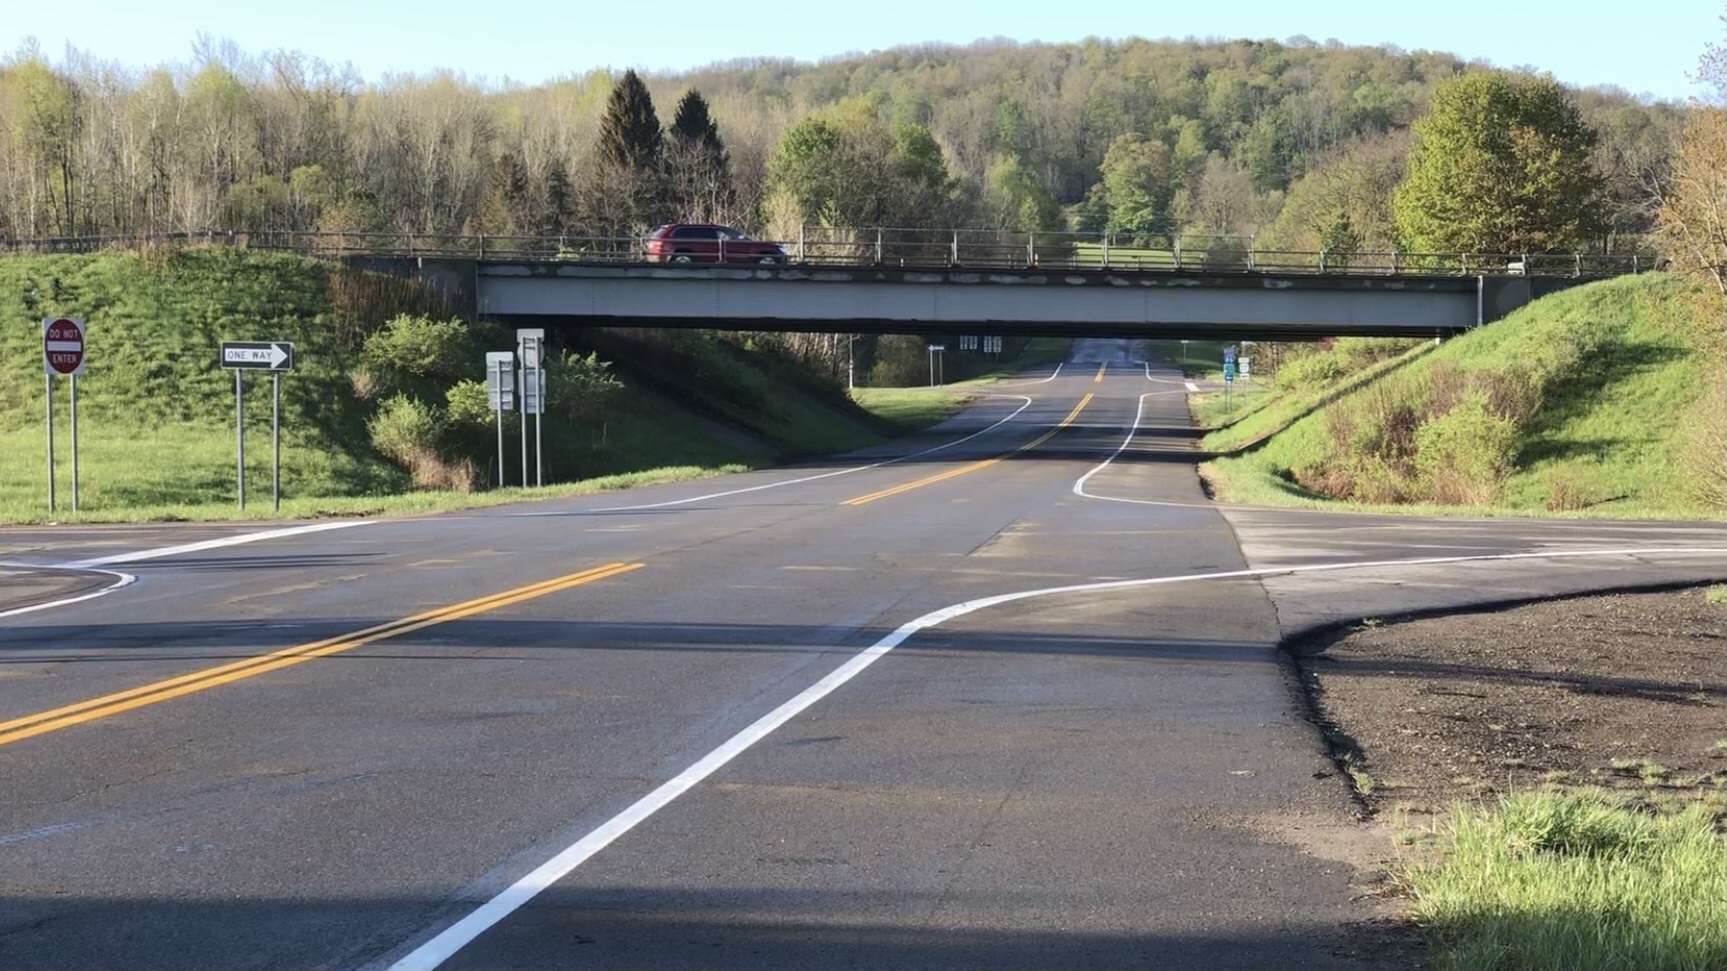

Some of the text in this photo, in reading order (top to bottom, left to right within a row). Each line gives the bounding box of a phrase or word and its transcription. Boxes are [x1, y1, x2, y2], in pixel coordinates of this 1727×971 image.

[49, 329, 78, 339] DO NOT
[52, 354, 77, 363] ENTER
[227, 351, 272, 360] ONE WAY
